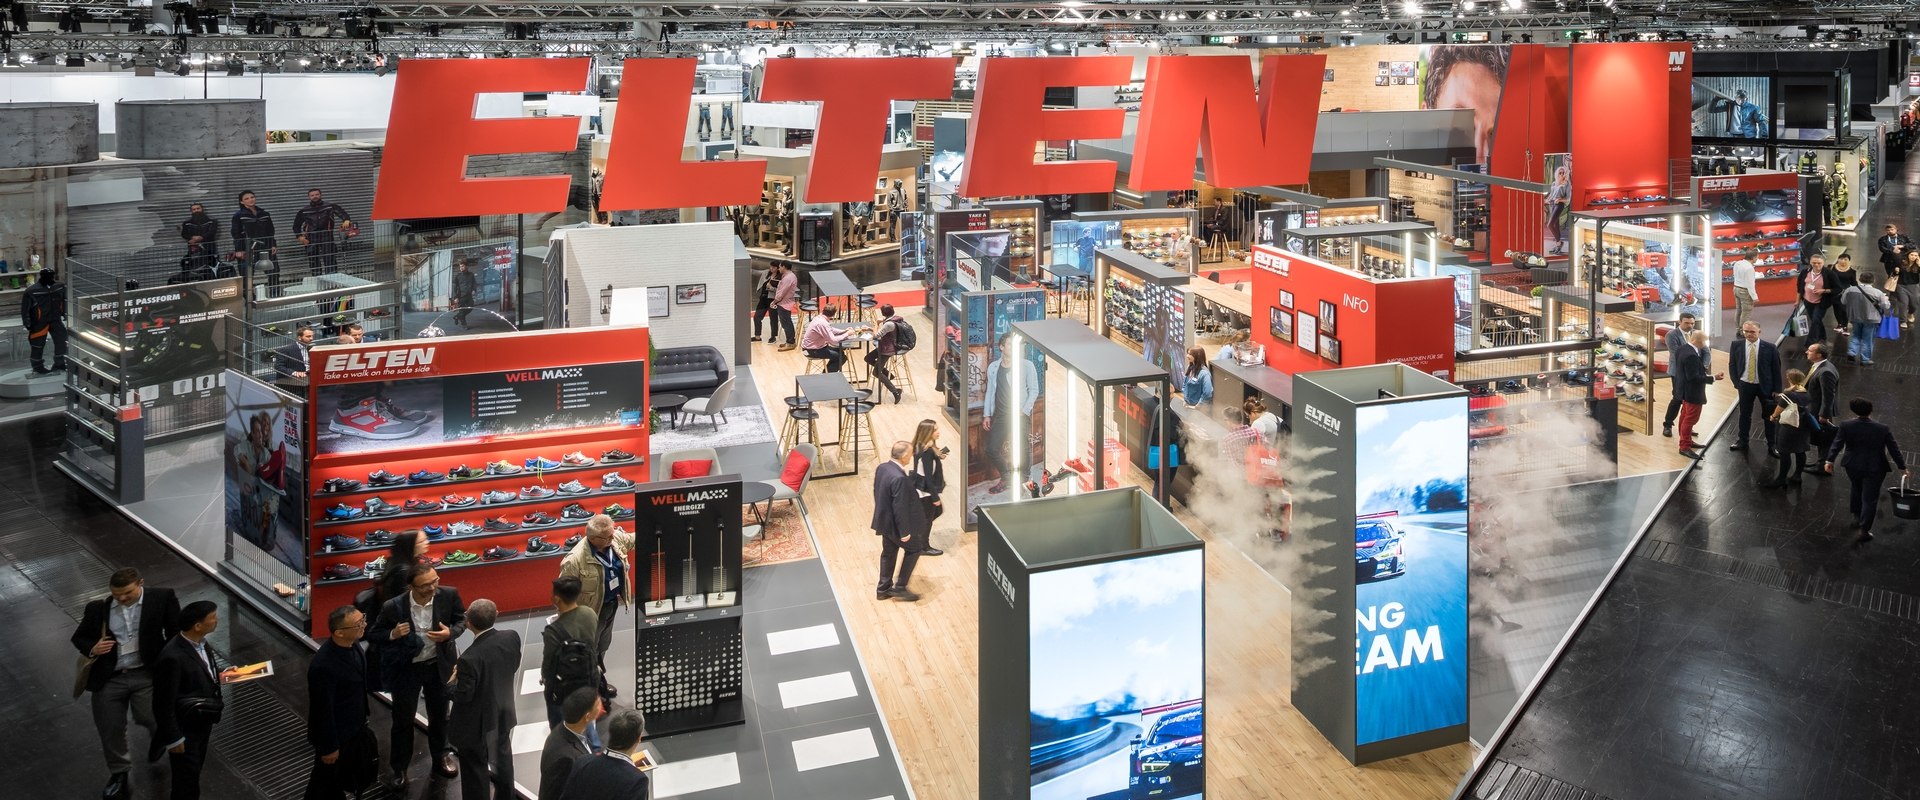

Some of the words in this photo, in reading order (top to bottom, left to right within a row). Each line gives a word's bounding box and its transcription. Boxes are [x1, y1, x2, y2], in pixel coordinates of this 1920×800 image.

[372, 54, 1326, 220] ELTEN
[1702, 178, 1739, 188] ELTEN
[1254, 250, 1290, 271] ELTEN
[91, 300, 133, 312] PERFETE
[135, 293, 181, 306] PASSFORM
[130, 307, 143, 315] FIT
[1342, 292, 1369, 313] INFO
[324, 347, 436, 372] ELTEN
[383, 367, 395, 375] the
[397, 365, 413, 374] safe
[414, 364, 430, 373] side
[1118, 392, 1148, 427] ELTE
[1304, 403, 1341, 431] ELTEN
[673, 503, 706, 512] ENERGIZE
[987, 552, 1016, 603] ELTEN
[1356, 625, 1444, 675] AM
